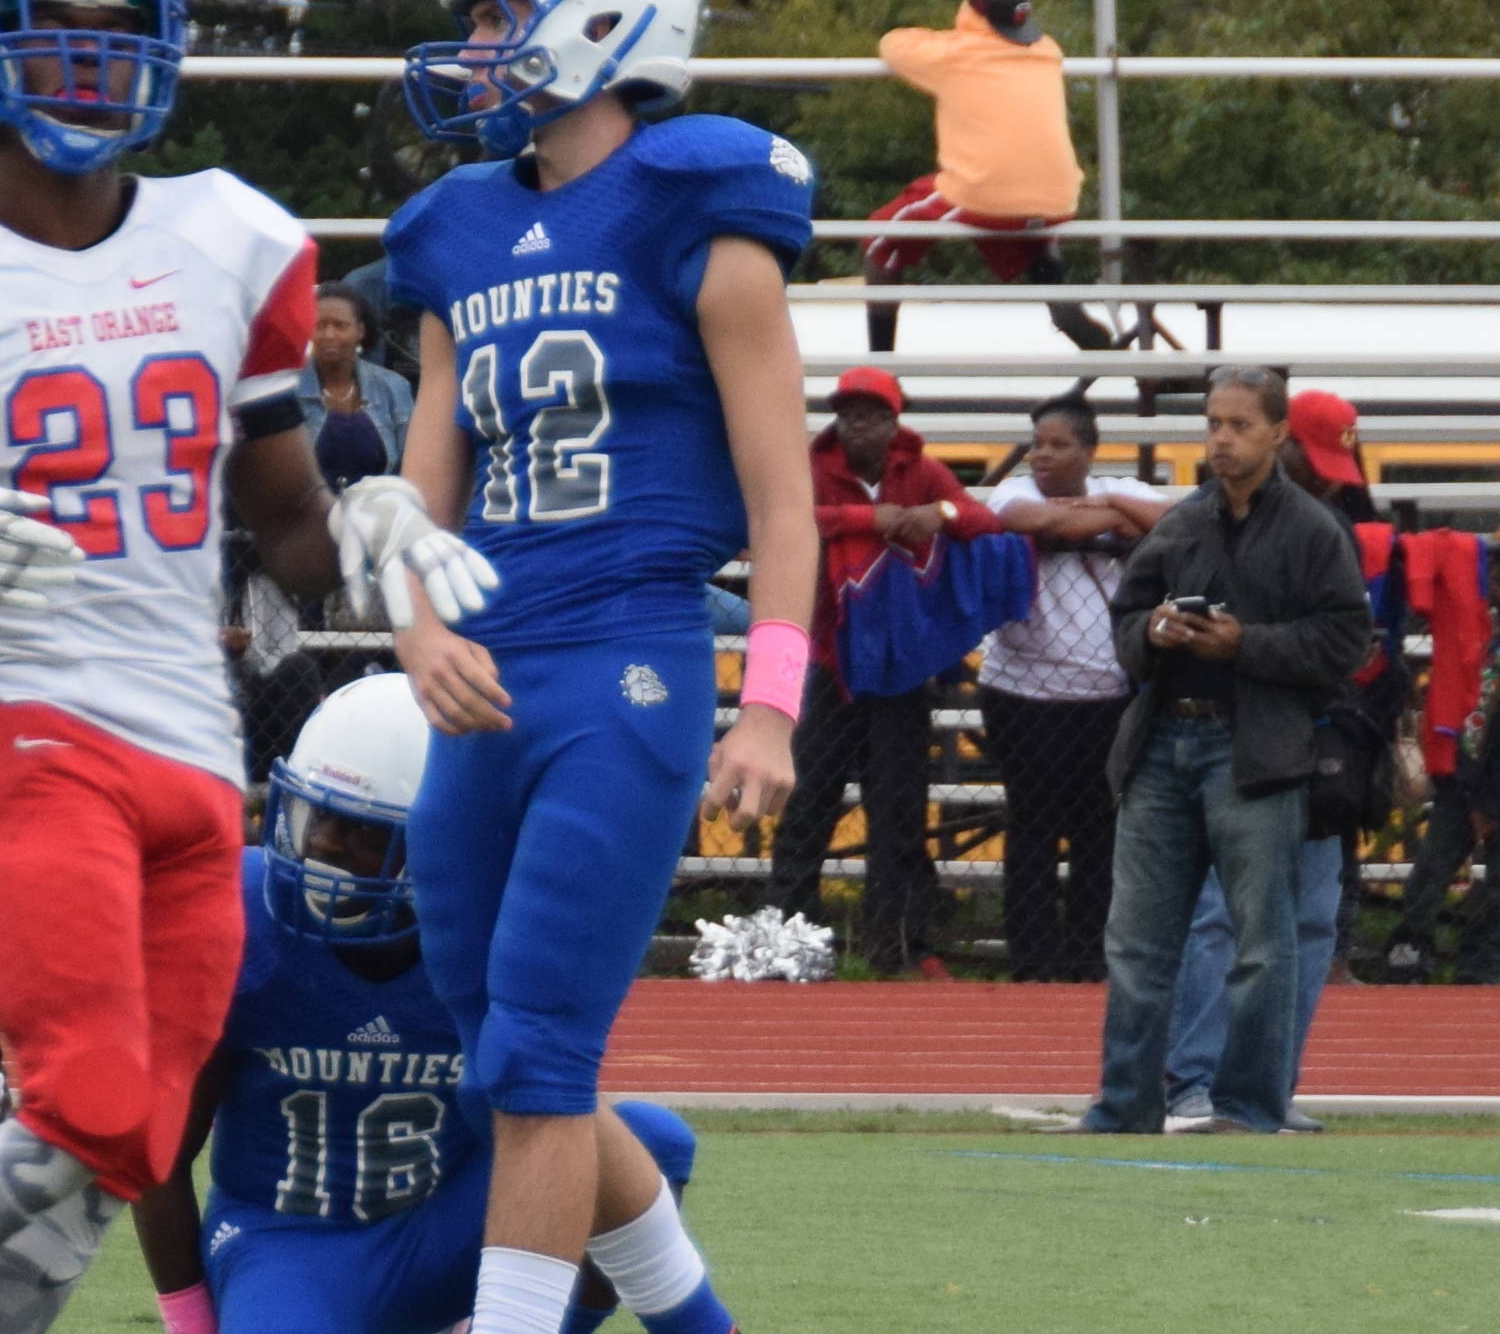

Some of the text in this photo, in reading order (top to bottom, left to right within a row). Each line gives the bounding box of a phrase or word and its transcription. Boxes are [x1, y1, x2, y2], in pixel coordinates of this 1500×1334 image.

[511, 237, 551, 255] adidas
[26, 302, 180, 351] EAST ORANGE
[450, 270, 620, 343] MOUNTIES
[4, 350, 221, 561] 23
[462, 329, 610, 521] 12
[347, 1032, 400, 1044] adidas
[274, 1089, 446, 1220] 16
